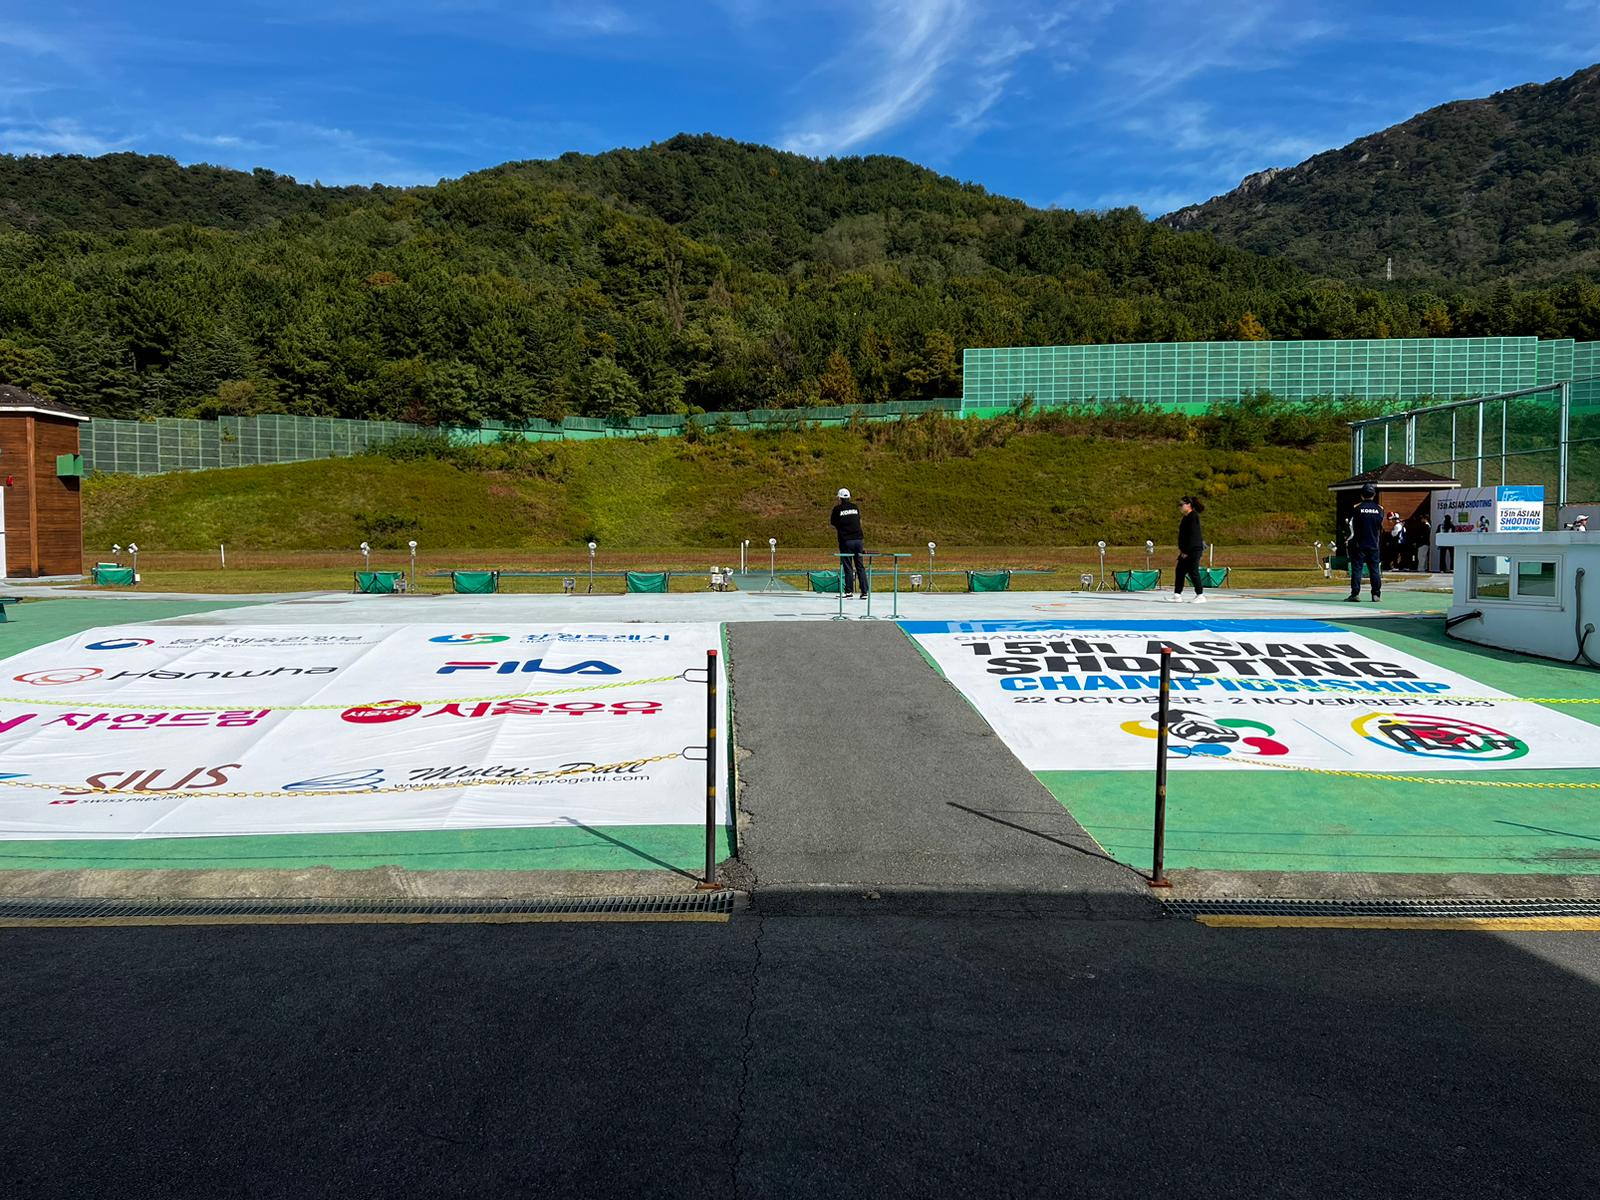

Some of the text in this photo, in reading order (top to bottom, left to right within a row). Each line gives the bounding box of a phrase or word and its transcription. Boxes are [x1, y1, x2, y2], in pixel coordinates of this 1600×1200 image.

[1448, 500, 1465, 509] ASIAN
[1465, 499, 1492, 509] SHOOTING
[1499, 517, 1541, 525] SHOOTING
[1516, 510, 1541, 518] ASIAN
[961, 637, 1368, 660] 15th ASIAN
[106, 666, 339, 681] Hanwha
[436, 658, 623, 675] FILA
[986, 655, 1421, 679] SHOOTING
[1000, 674, 1451, 695] CHAMPIONSHIP
[1013, 696, 1045, 704] 22
[1054, 695, 1206, 705] OCTOBER
[1227, 697, 1247, 705] 2
[1251, 696, 1425, 708] NOVEMBER
[1434, 699, 1496, 708] 2023
[41, 708, 272, 731] 자연드림
[60, 763, 242, 796] SIUS
